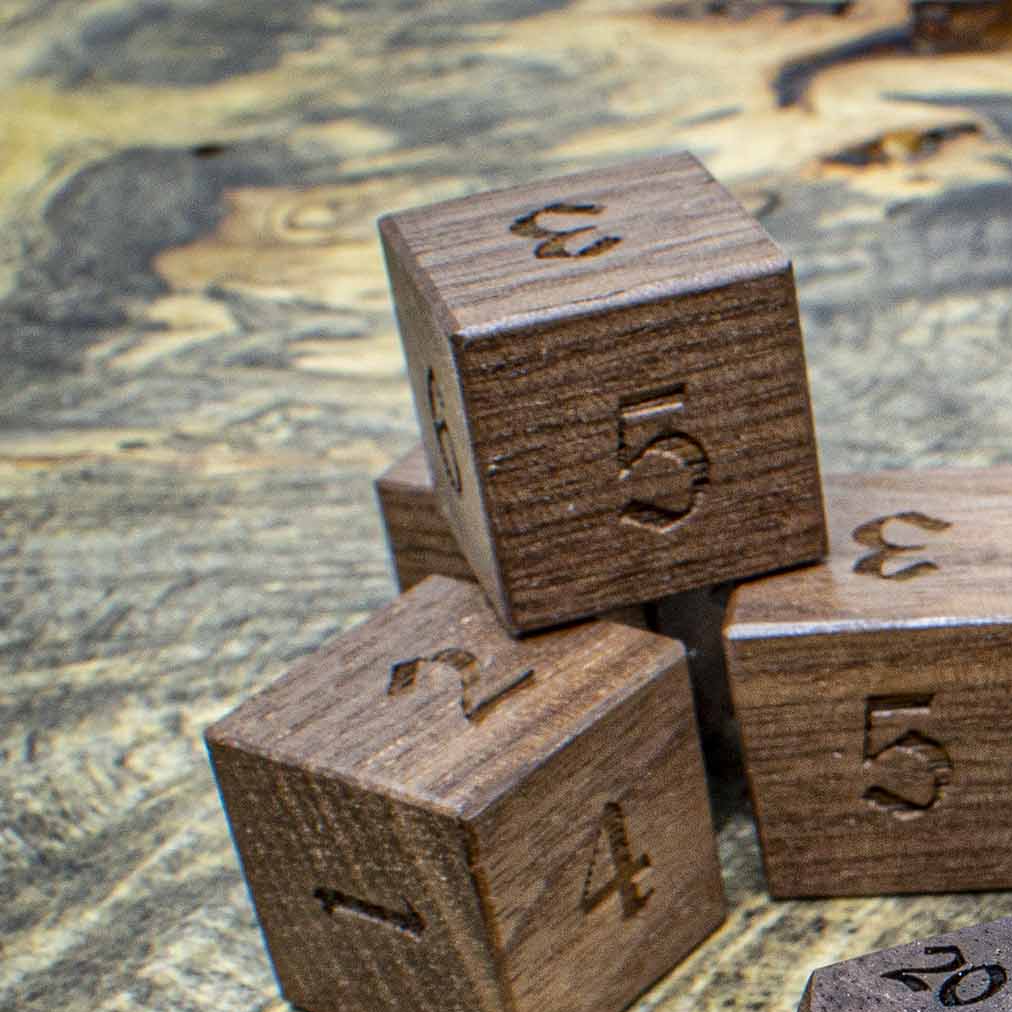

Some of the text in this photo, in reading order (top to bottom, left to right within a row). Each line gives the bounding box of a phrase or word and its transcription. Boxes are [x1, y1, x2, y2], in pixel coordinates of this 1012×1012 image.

[509, 202, 622, 259] 3
[617, 383, 711, 534] 5
[852, 511, 952, 580] 3
[387, 648, 536, 721] 2
[863, 693, 954, 820] 5
[580, 802, 655, 918] 4
[314, 886, 428, 938] 1
[880, 945, 1008, 1006] 20
